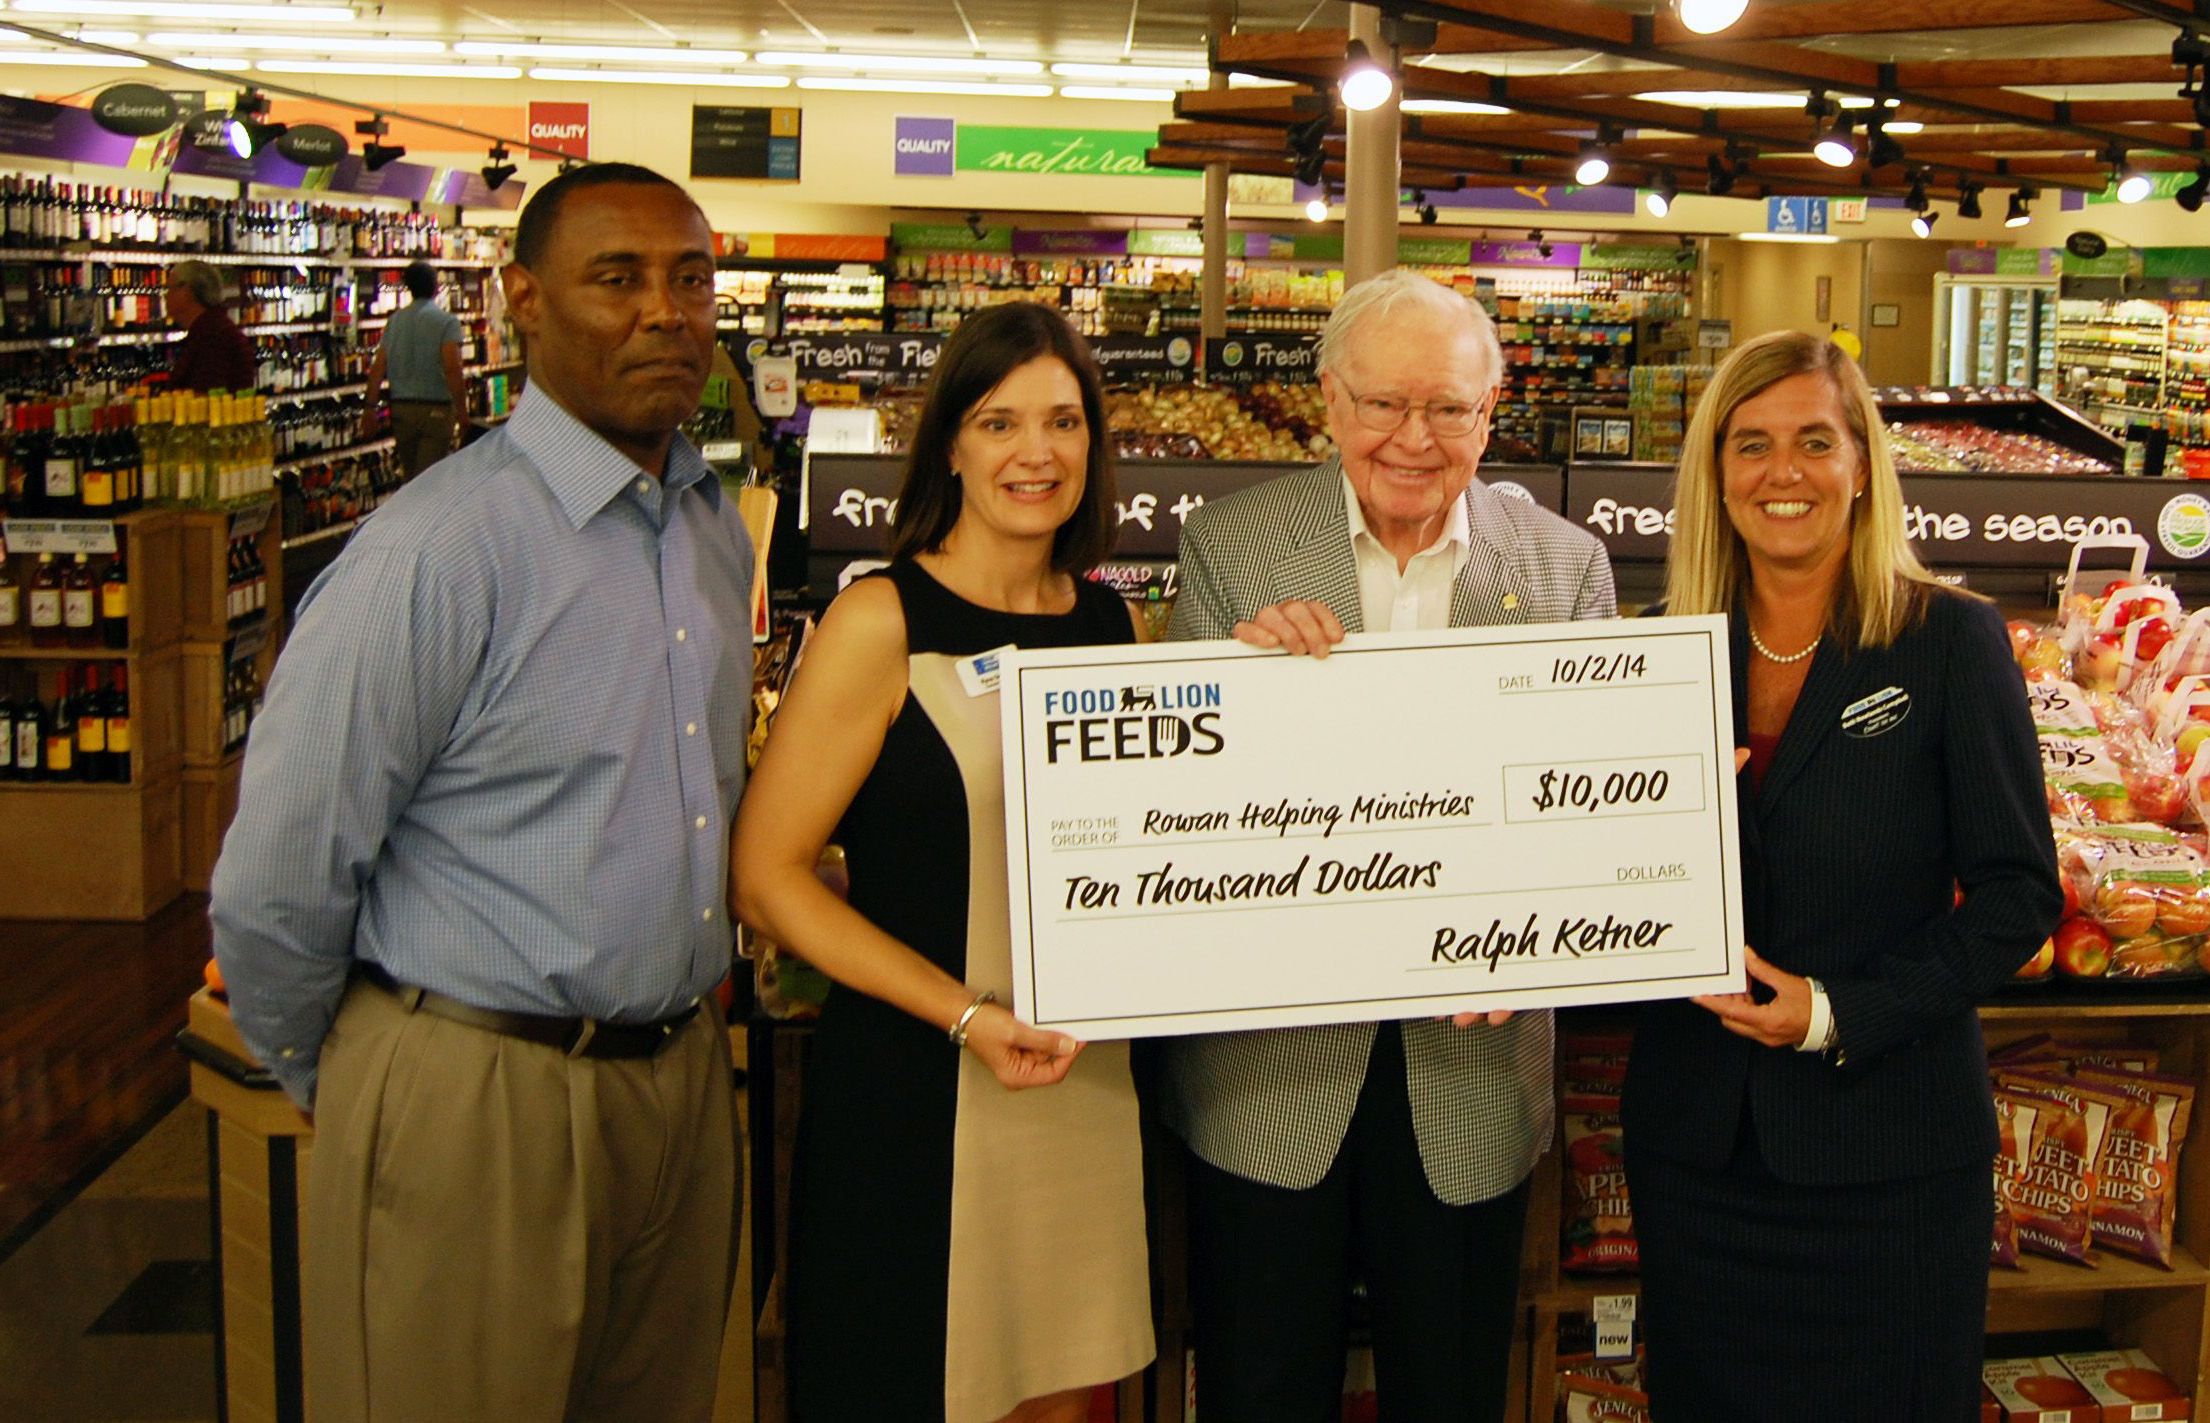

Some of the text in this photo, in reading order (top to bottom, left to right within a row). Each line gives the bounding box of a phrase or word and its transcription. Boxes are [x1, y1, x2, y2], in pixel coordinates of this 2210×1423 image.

[103, 104, 167, 117] Cabernet
[292, 138, 332, 151] Merlot
[531, 123, 586, 138] QUALITY
[896, 138, 951, 154] QUALITY
[981, 136, 1153, 173] natura
[788, 339, 941, 368] Fresh from Fiel
[867, 355, 886, 367] the
[1255, 342, 1312, 367] Fresh
[1115, 493, 1158, 531] f
[1586, 498, 1678, 536] fres
[1902, 503, 1971, 541] the
[1983, 513, 2133, 544] season
[1098, 565, 1153, 585] NAGOLD
[1499, 653, 1647, 690] DATE 10/2/14
[1045, 683, 1221, 715] FOOD LION
[1046, 712, 1225, 764] FEEDS
[1532, 769, 1669, 812] $10,000
[1051, 816, 1120, 831] PAY TO THE
[1143, 789, 1475, 837] Rowan Helping Ministries
[1051, 831, 1120, 847] ORDER OF
[1064, 852, 1442, 910] Ten Thousand Dollars
[1617, 863, 1687, 881] DOLLARS
[1430, 912, 1674, 973] Ralph Ketner
[2035, 1143, 2087, 1177] EET
[2106, 1136, 2160, 1166] EET
[1577, 1171, 1627, 1199] APP
[2103, 1155, 2162, 1190] TATO
[2001, 1179, 2072, 1214] CHIPS
[2096, 1179, 2146, 1203] HIPS
[2017, 1227, 2068, 1252] NAMON
[1599, 1335, 1629, 1346] new
